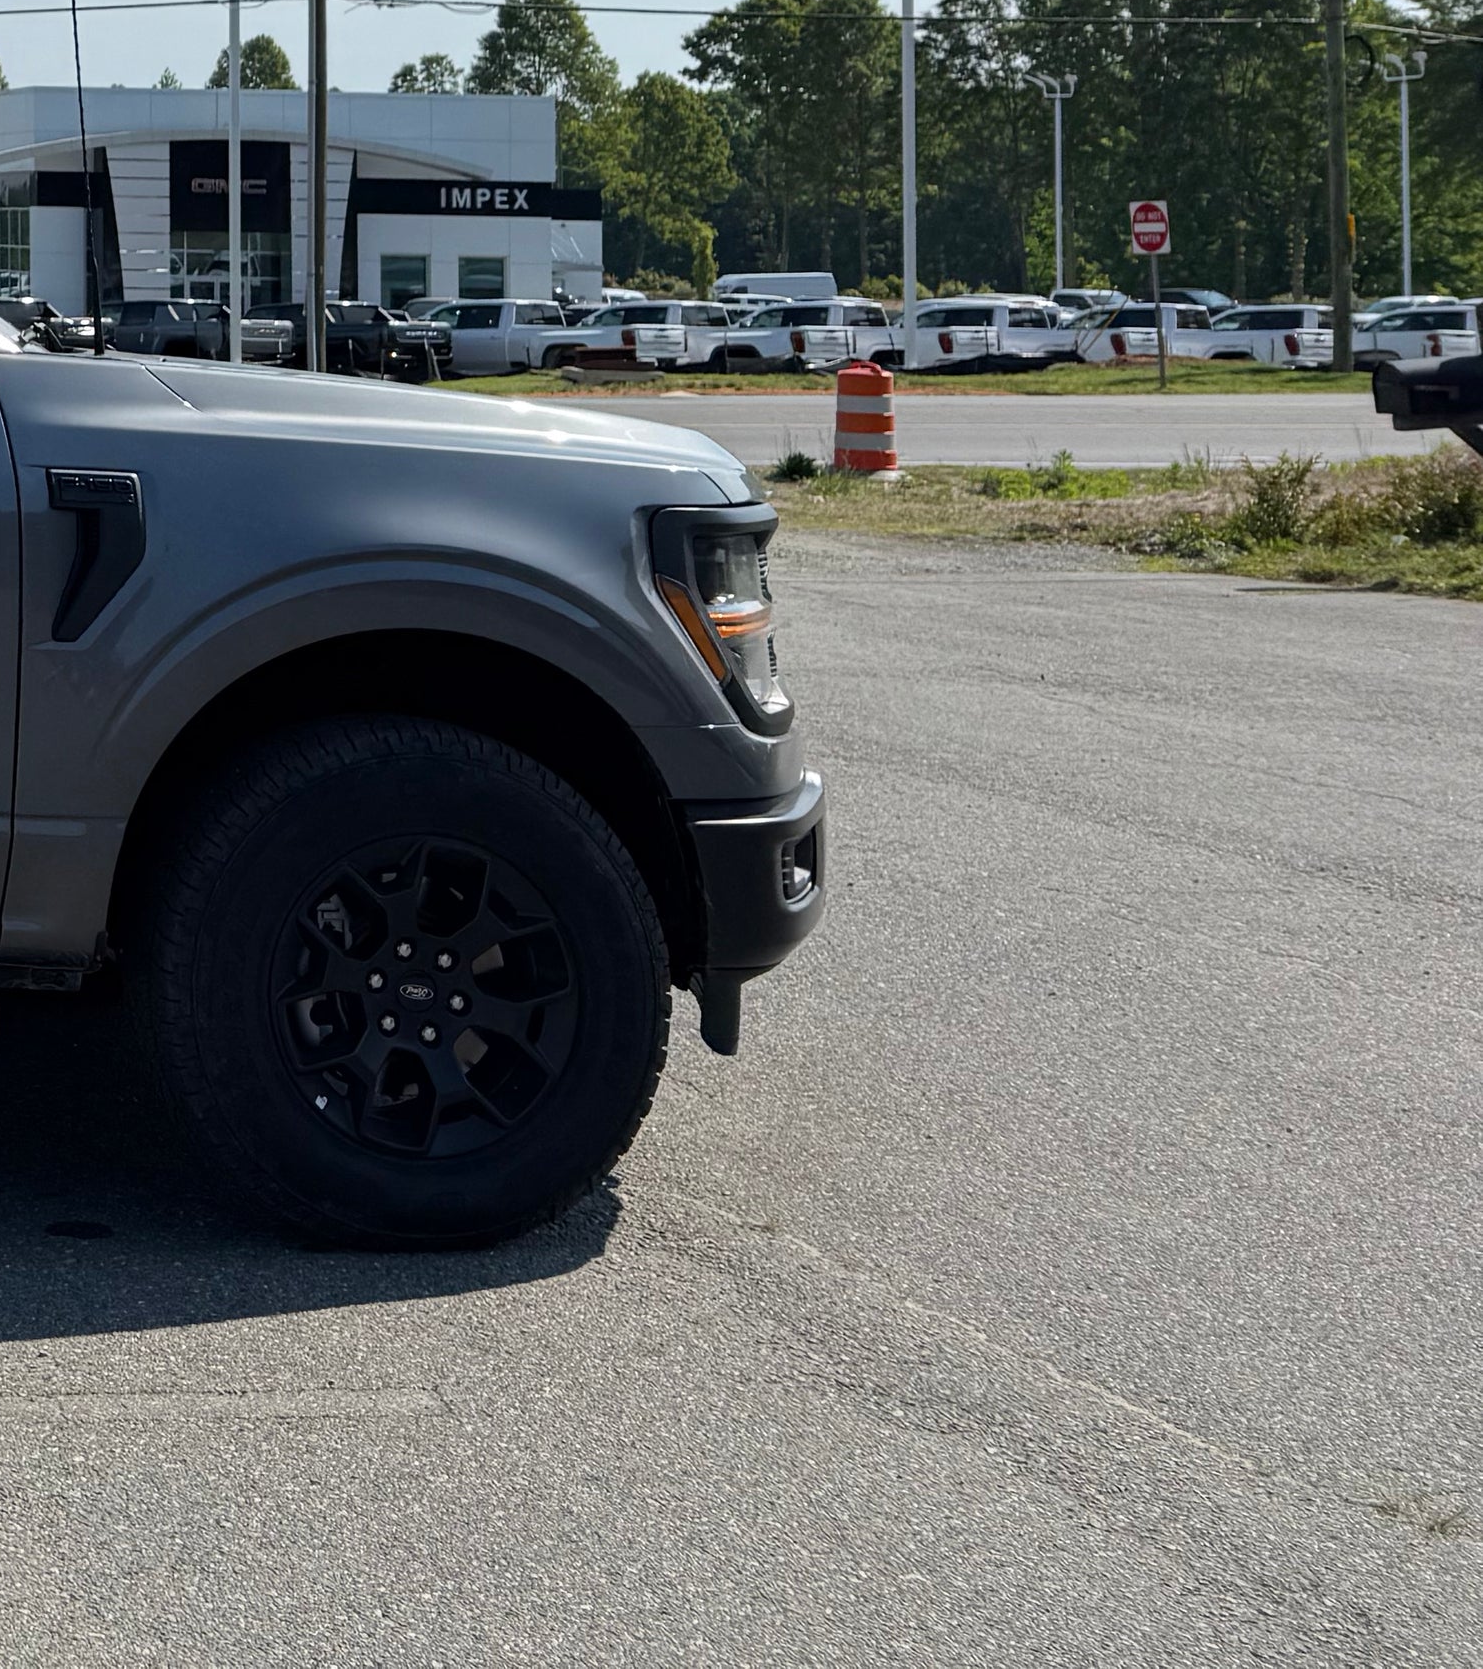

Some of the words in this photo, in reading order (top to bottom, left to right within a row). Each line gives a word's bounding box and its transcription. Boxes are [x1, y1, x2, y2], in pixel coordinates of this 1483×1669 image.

[440, 187, 529, 210] IMPEX
[1135, 211, 1146, 222] DO
[1147, 211, 1161, 221] NOT
[1139, 234, 1161, 244] ENTER
